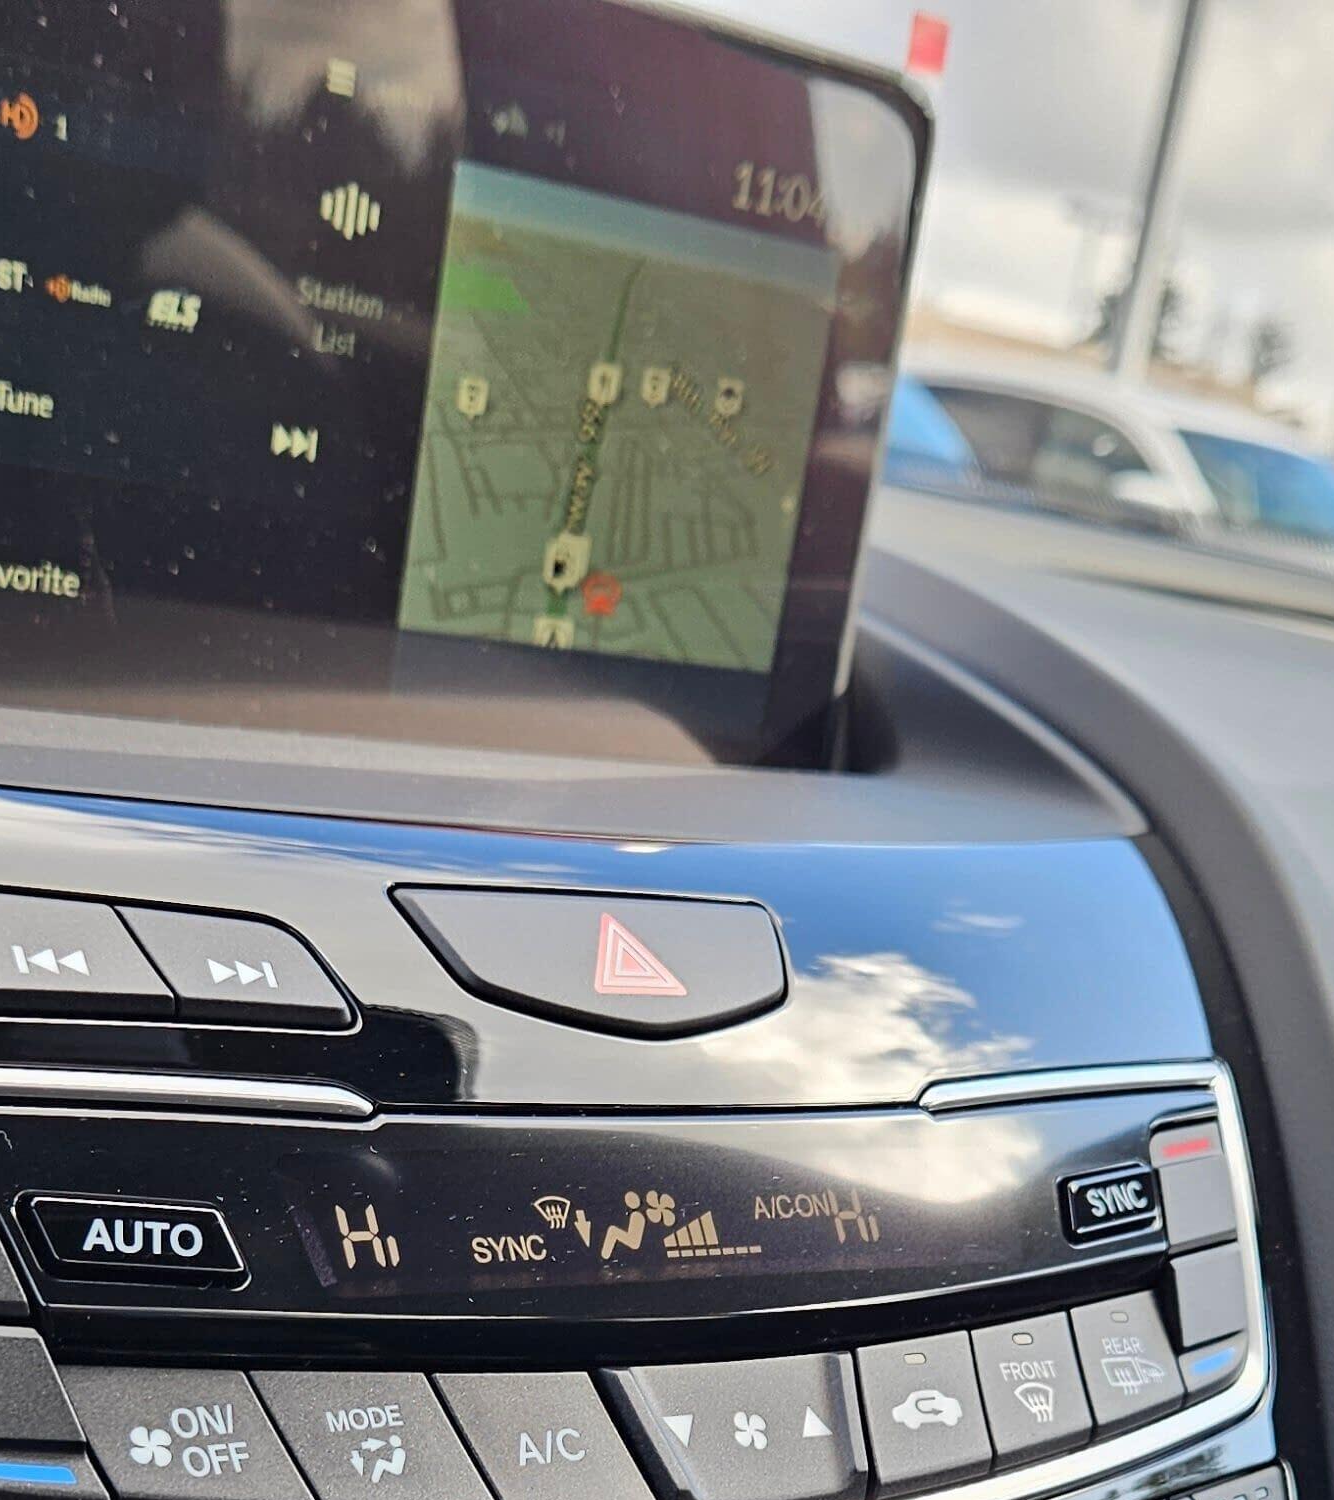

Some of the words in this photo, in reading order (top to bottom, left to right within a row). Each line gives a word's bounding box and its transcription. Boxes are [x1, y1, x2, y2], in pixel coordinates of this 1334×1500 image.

[298, 276, 384, 320] Station
[315, 322, 355, 358] List
[1086, 1180, 1148, 1217] SYNC
[83, 1219, 202, 1257] AUTO
[471, 1235, 547, 1264] SYNC
[1101, 1336, 1143, 1355] REAR
[999, 1360, 1056, 1381] FRONT
[171, 1403, 234, 1438] ON/
[325, 1404, 404, 1432] MODE
[181, 1442, 249, 1477] OFF
[519, 1429, 586, 1465] A/C
